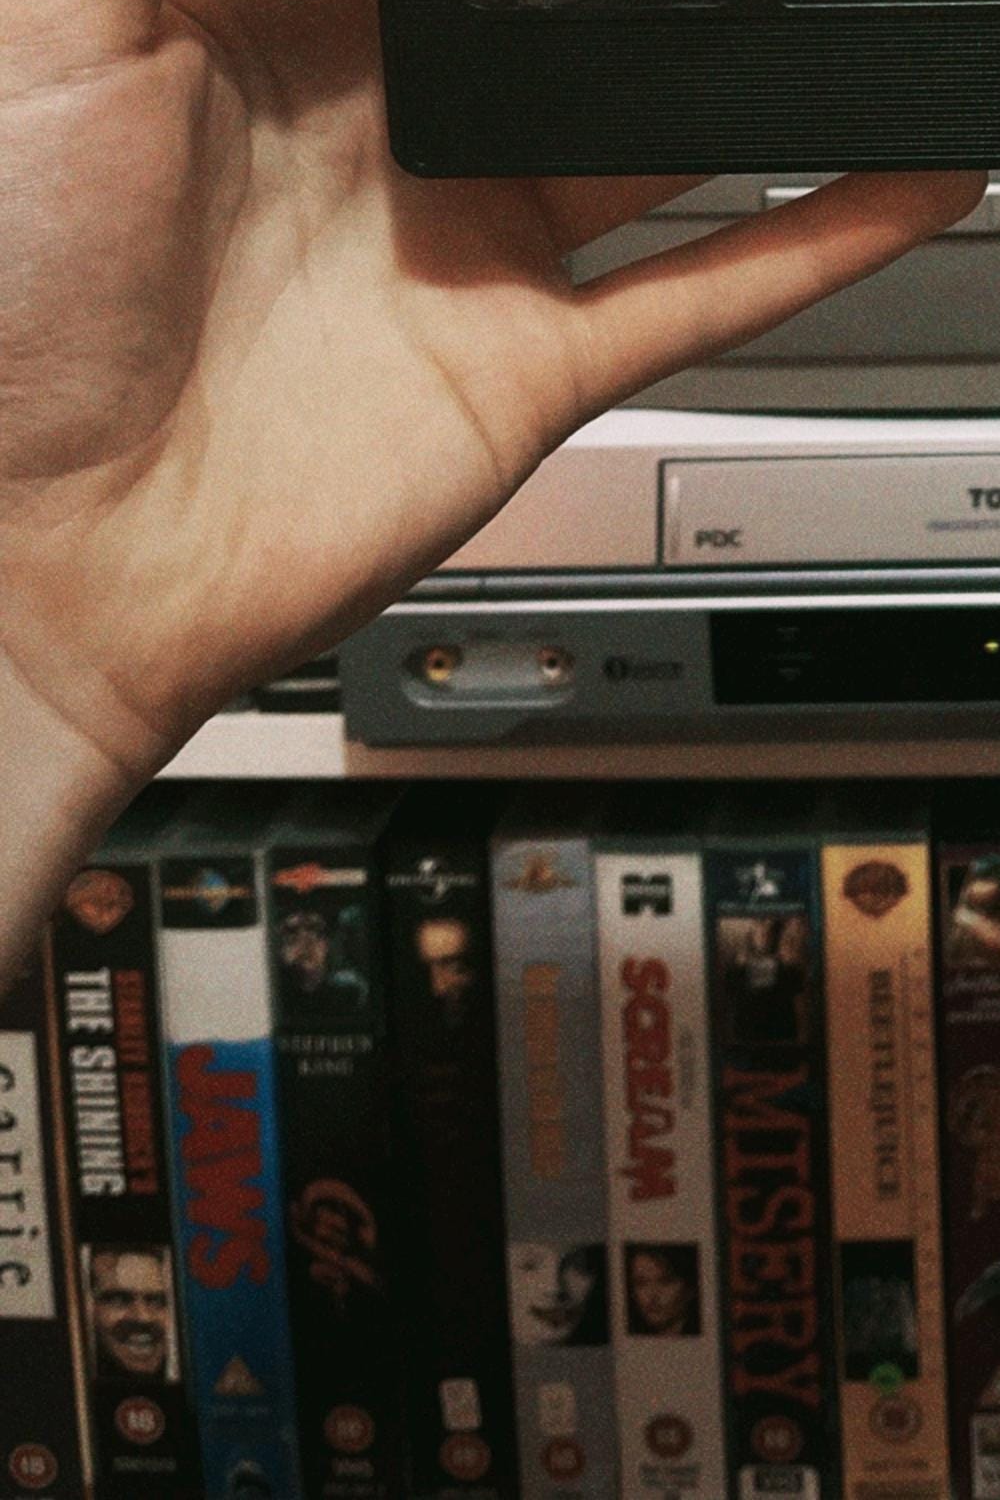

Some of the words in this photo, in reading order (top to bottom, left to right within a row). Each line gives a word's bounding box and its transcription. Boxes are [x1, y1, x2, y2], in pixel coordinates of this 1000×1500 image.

[64, 967, 114, 1033] THE
[69, 1045, 126, 1198] SHINING
[617, 955, 679, 1206] SCREAM
[176, 1043, 271, 1290] JAWS
[722, 1060, 821, 1410] MISERY
